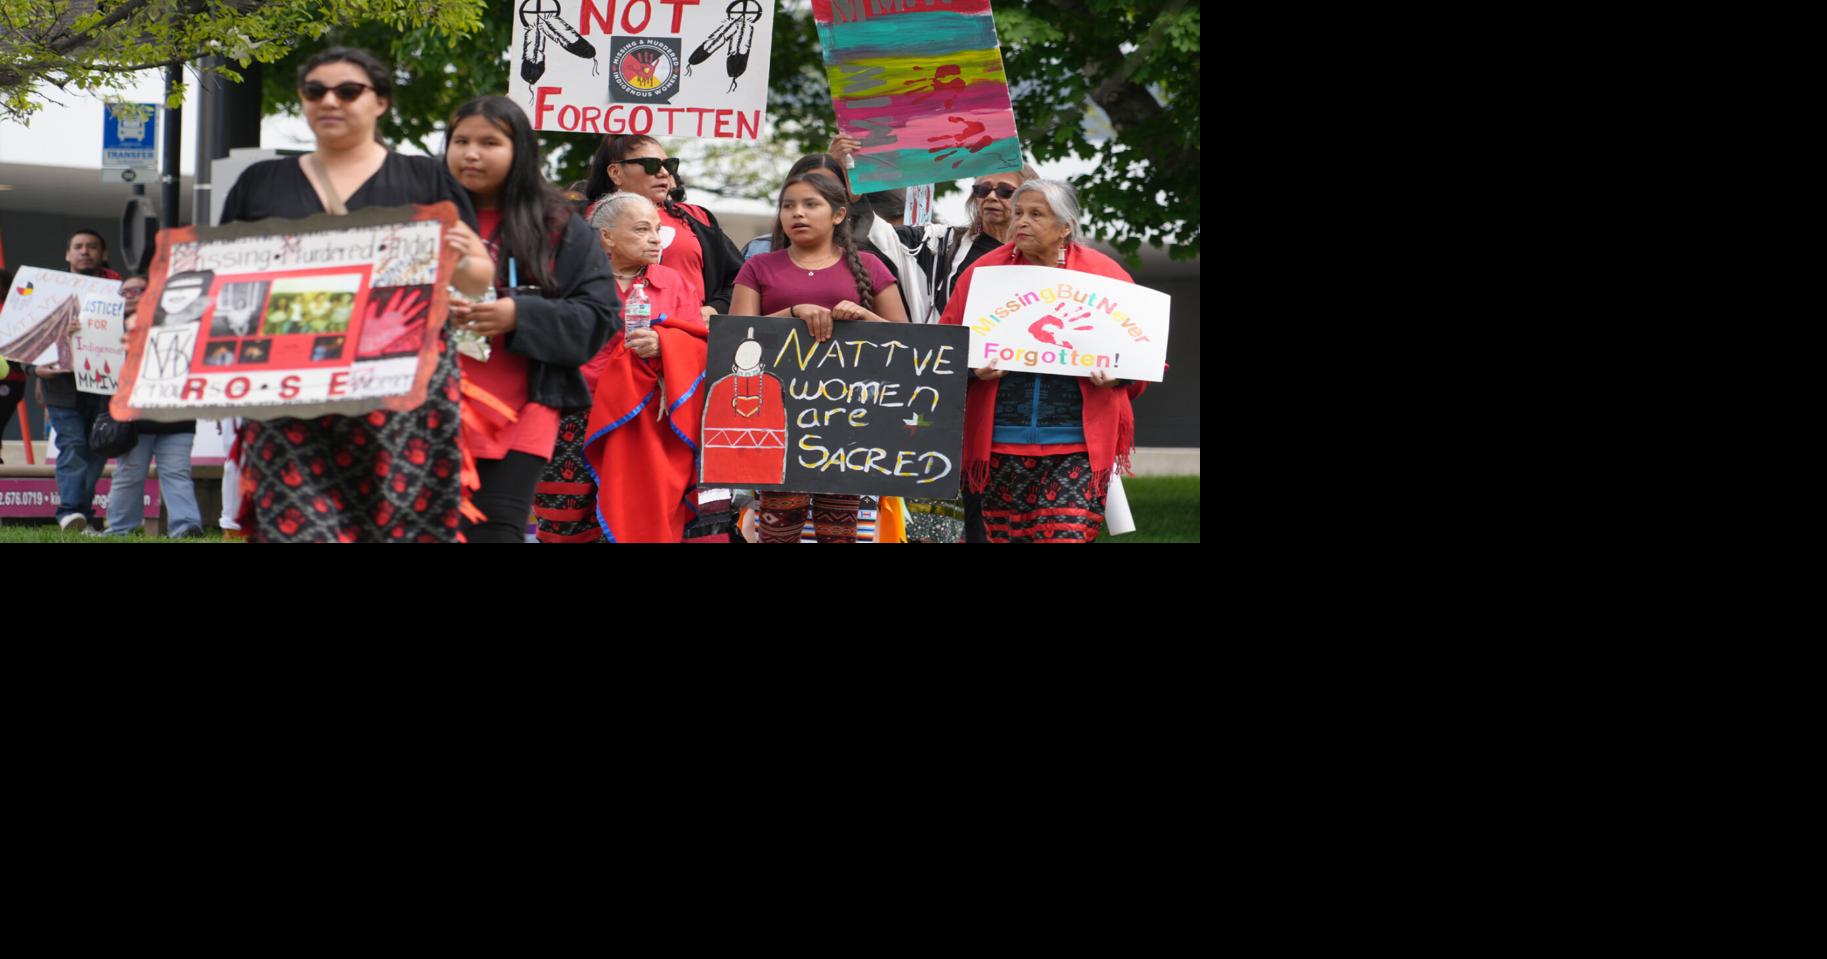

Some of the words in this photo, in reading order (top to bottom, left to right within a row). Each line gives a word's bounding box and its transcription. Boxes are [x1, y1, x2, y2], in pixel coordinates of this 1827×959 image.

[579, 0, 700, 35] NOT
[613, 41, 637, 64] MISSING
[647, 39, 679, 66] MURDERED
[613, 71, 653, 97] INDIGENOUS
[654, 73, 678, 95] WOMEN
[534, 86, 761, 139] FORGOTTEN
[106, 150, 154, 158] TRANSFER
[87, 319, 108, 331] FOR
[984, 342, 1120, 369] Forgotten!
[797, 407, 870, 429] are
[798, 434, 953, 485] SACRED
